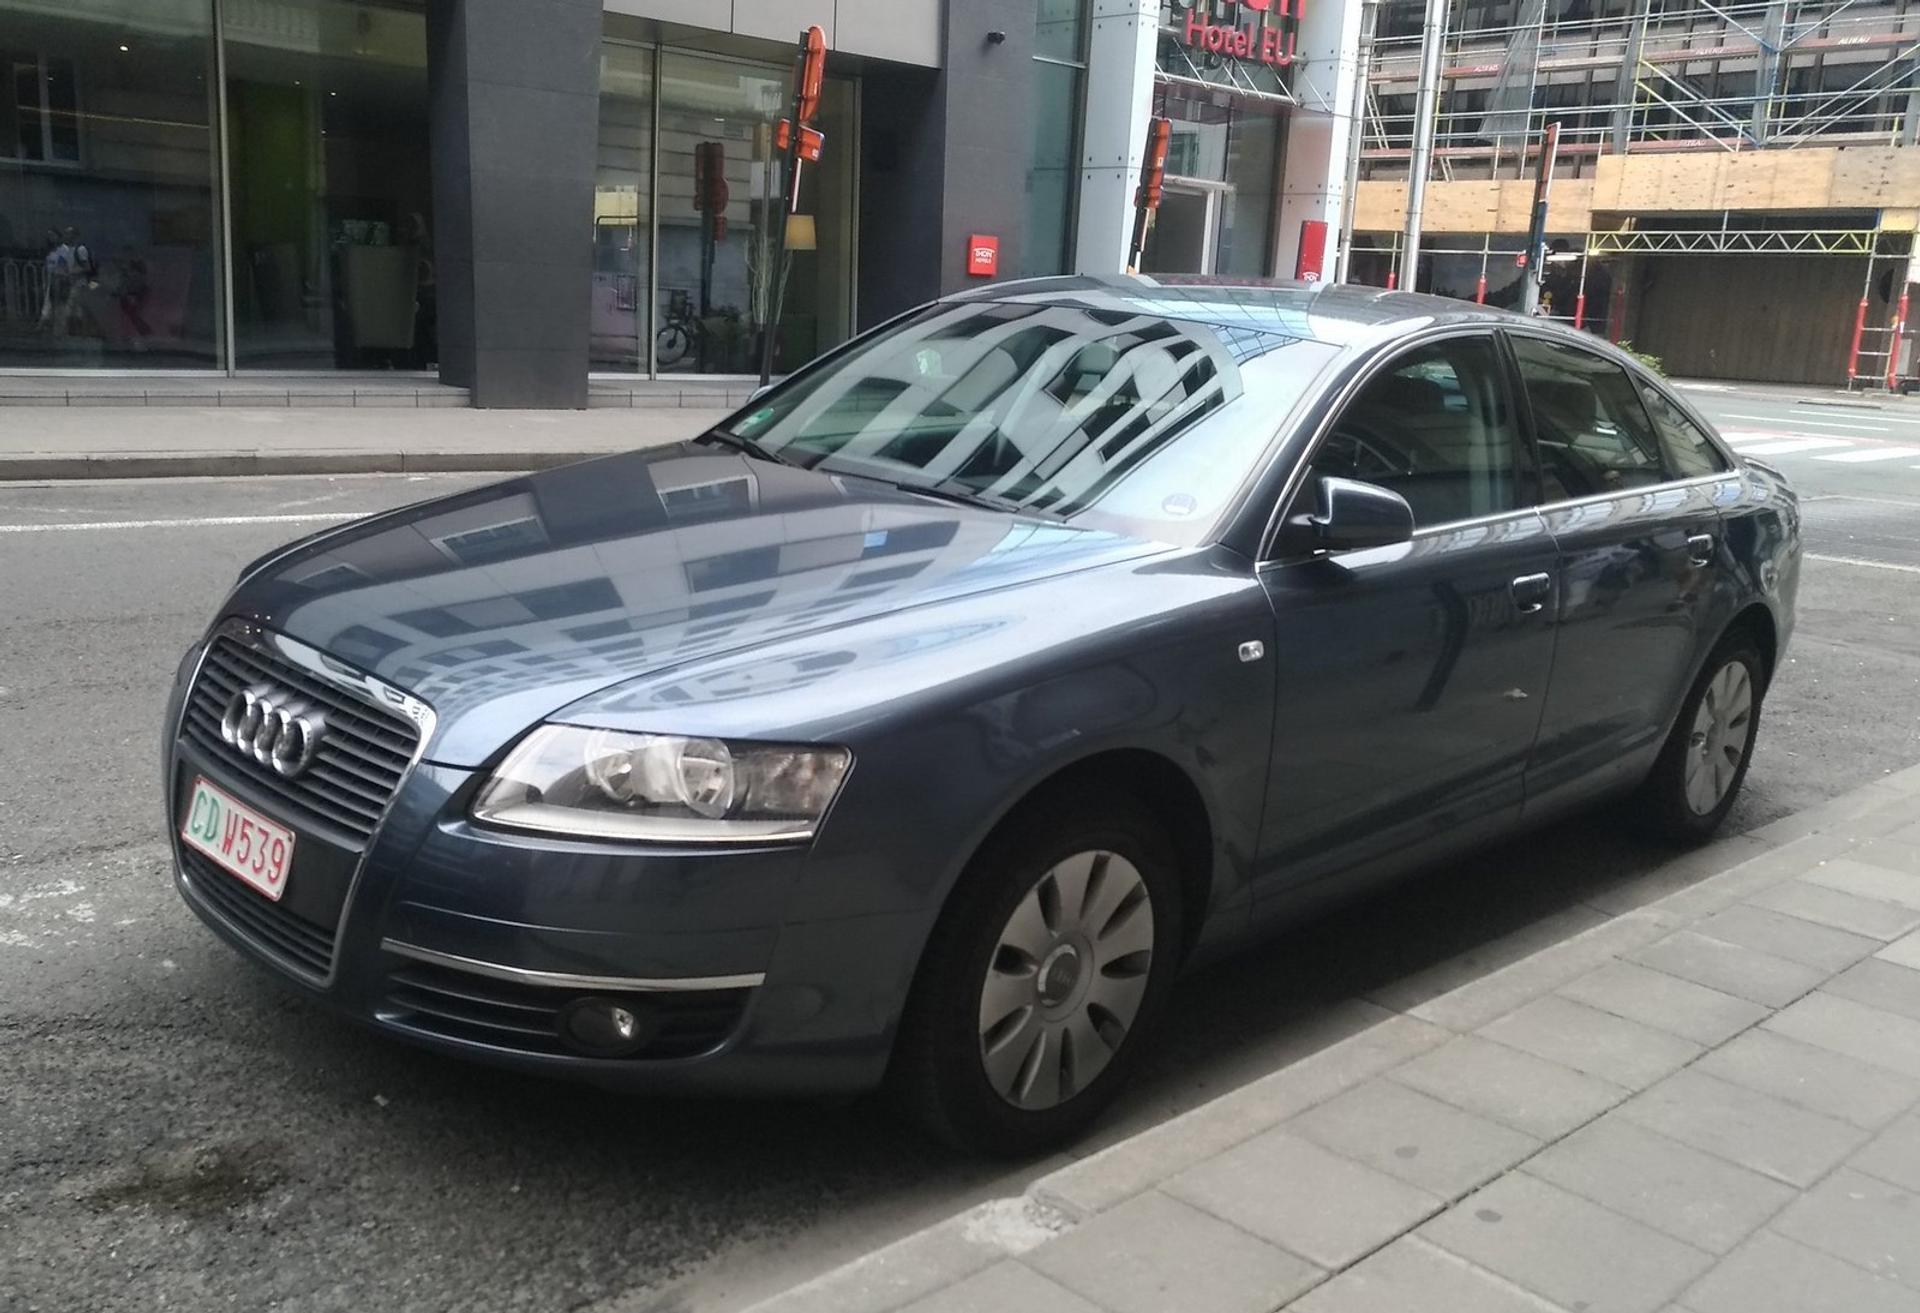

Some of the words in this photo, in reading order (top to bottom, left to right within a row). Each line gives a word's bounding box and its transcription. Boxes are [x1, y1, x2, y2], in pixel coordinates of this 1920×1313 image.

[1185, 8, 1256, 57] Hotel
[1262, 26, 1295, 65] EU
[192, 790, 220, 842] CD
[222, 808, 285, 884] W539
